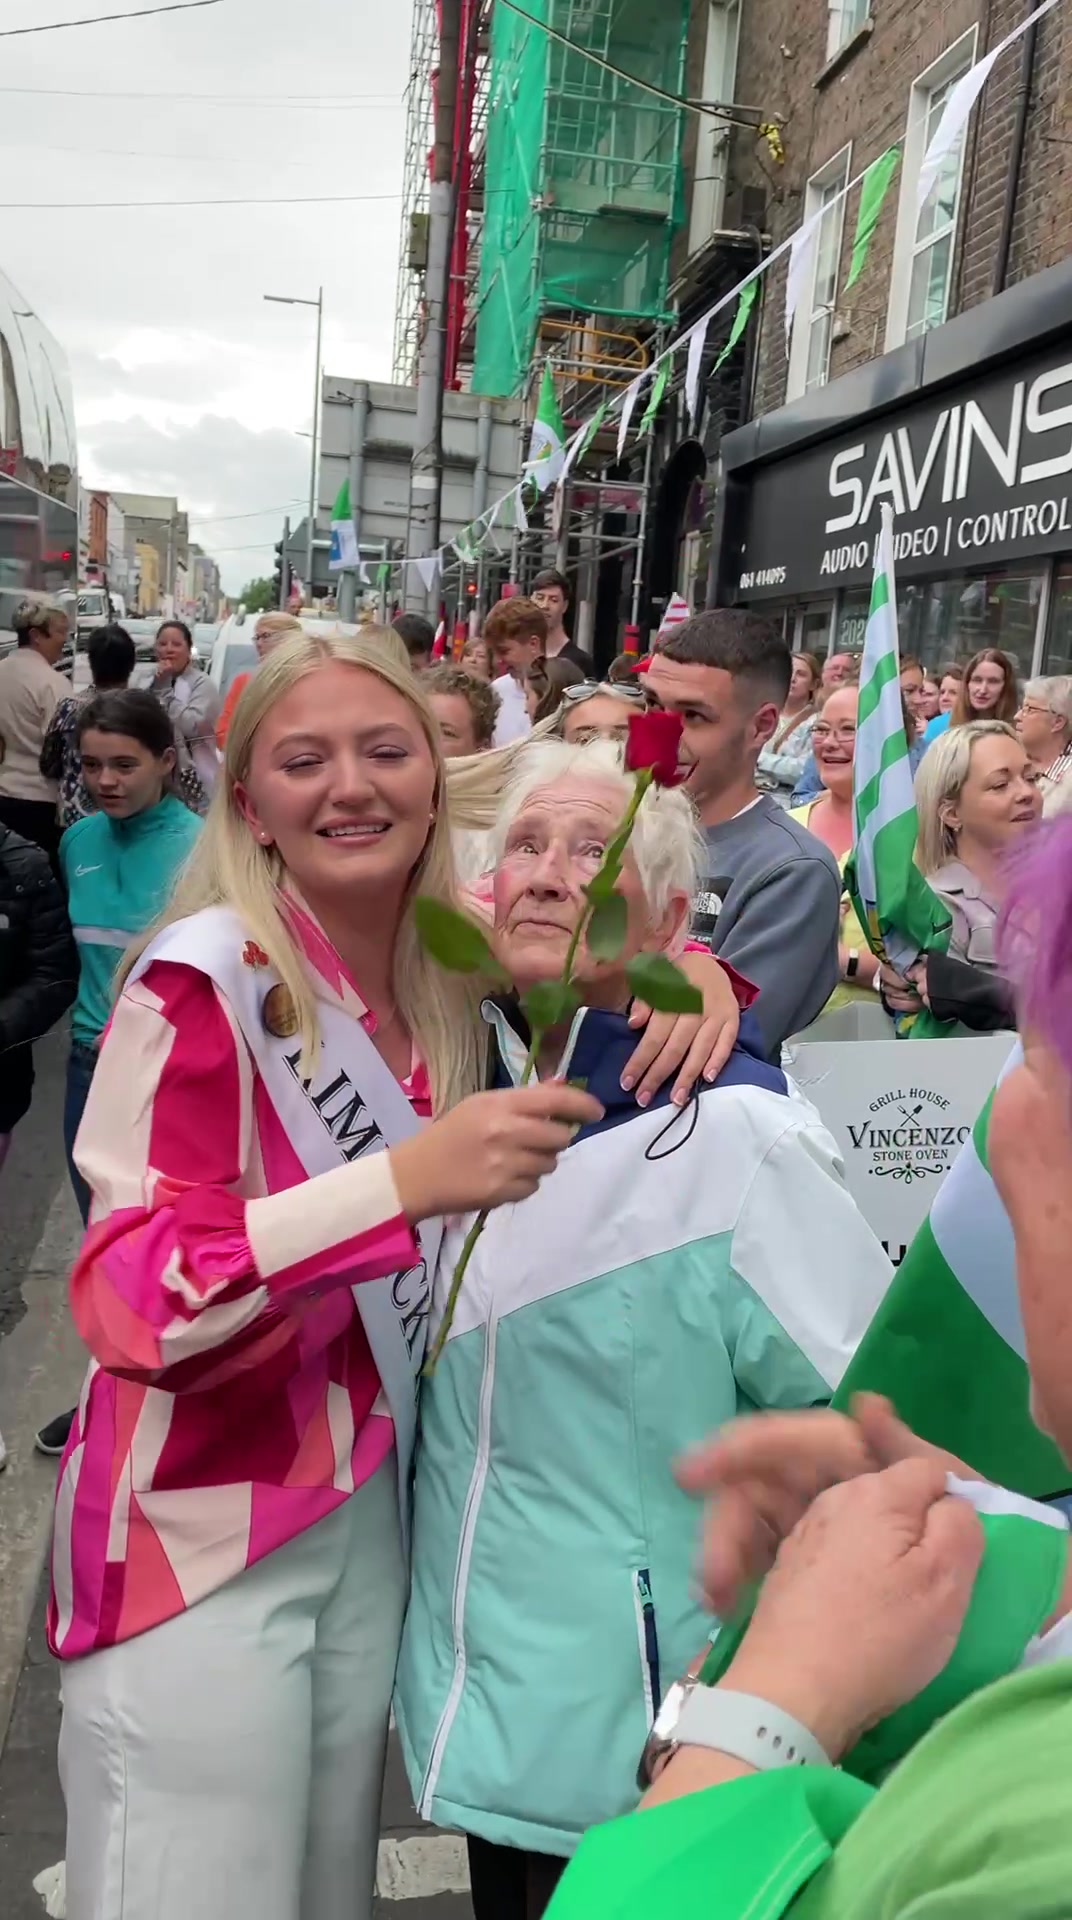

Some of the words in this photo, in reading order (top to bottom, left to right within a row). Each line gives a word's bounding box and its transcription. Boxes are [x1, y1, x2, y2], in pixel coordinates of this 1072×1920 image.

[825, 363, 1072, 533] SAVINS
[820, 541, 869, 575] AUDIO
[892, 525, 939, 561] IDEO
[957, 497, 1072, 549] CONTROL
[869, 1090, 906, 1112] GRILL
[910, 1088, 950, 1110] HOUSE
[873, 1151, 912, 1161] STONE
[916, 1149, 949, 1159] OVEN
